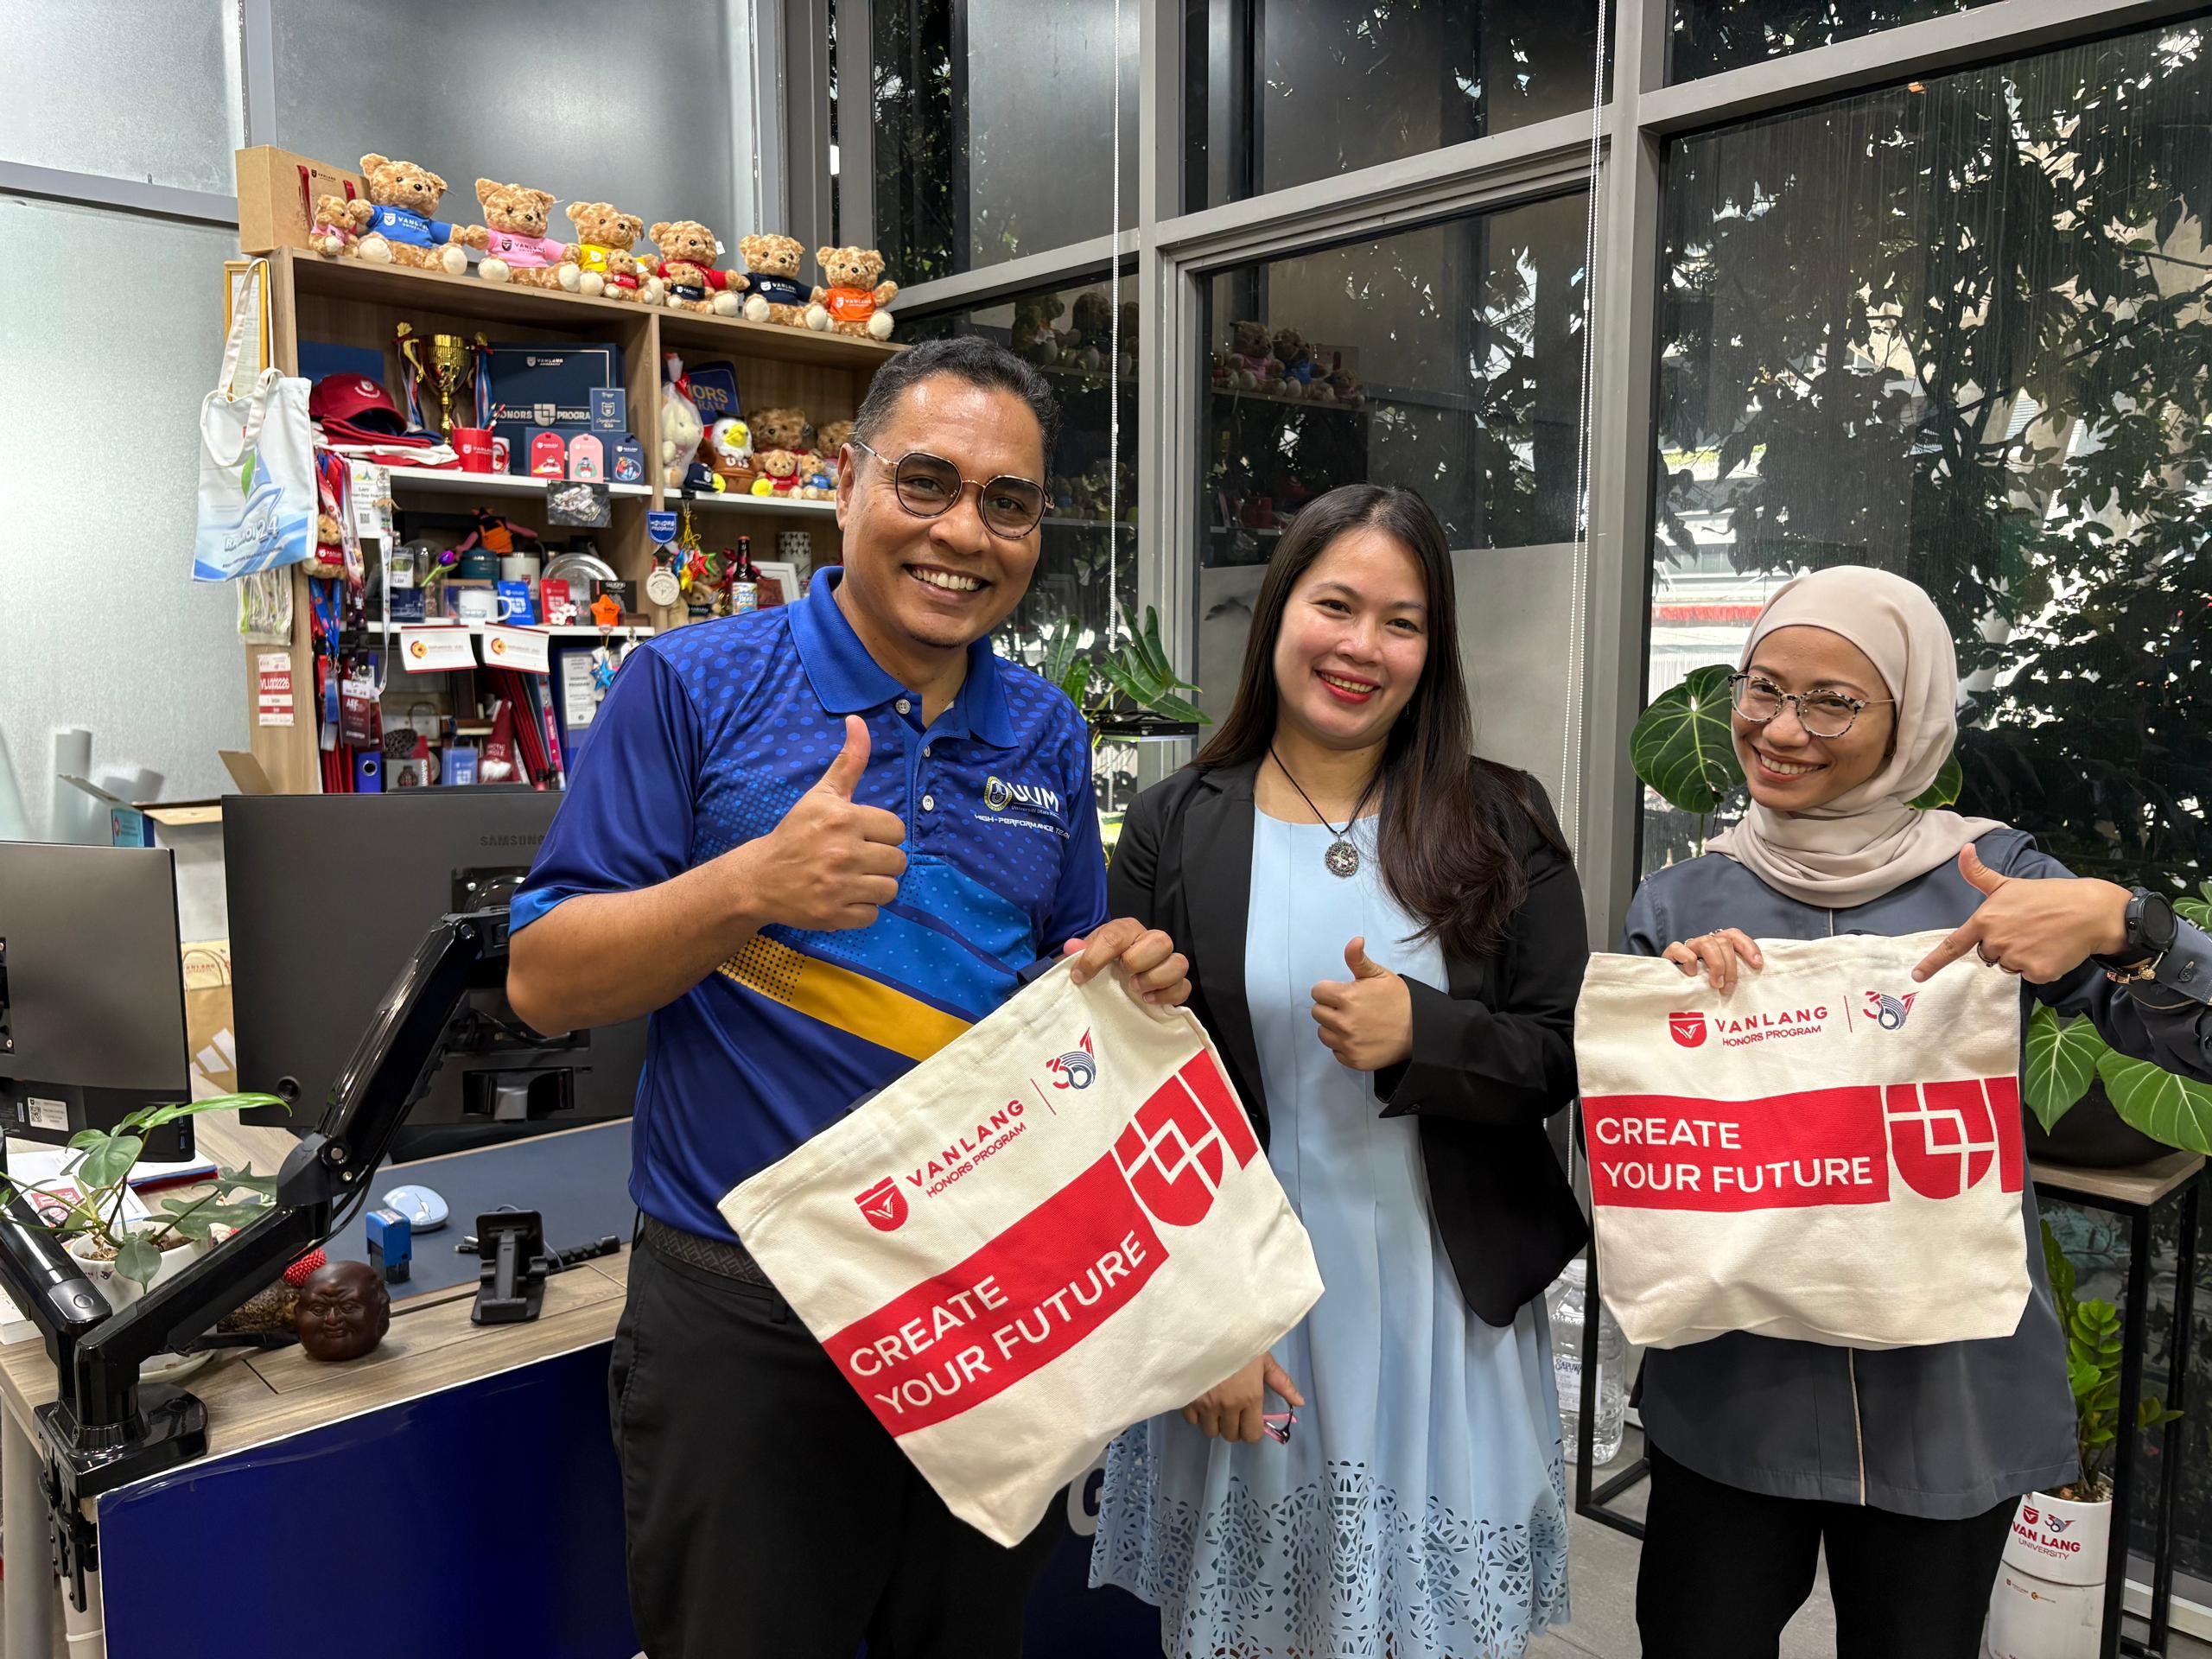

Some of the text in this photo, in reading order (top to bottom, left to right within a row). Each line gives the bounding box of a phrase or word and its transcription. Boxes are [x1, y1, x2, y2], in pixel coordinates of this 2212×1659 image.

[556, 410, 591, 420] PROGRA
[1007, 782, 1059, 812] UUM
[1715, 1006, 1828, 1033] VANLANG
[1722, 1025, 1821, 1047] HONORS PROGRAM
[906, 1099, 1025, 1188] VANLANG
[1595, 1117, 1742, 1150] CREATE
[926, 1122, 1027, 1198] HONORS PROGRAM
[1600, 1156, 1873, 1193] YOUR FUTURE
[849, 1274, 1009, 1376] CREATE
[874, 1230, 1147, 1414] YOUR FUTURE
[2012, 1521, 2082, 1554] VAN LANG
[2018, 1537, 2070, 1560] UNIVERSITY
